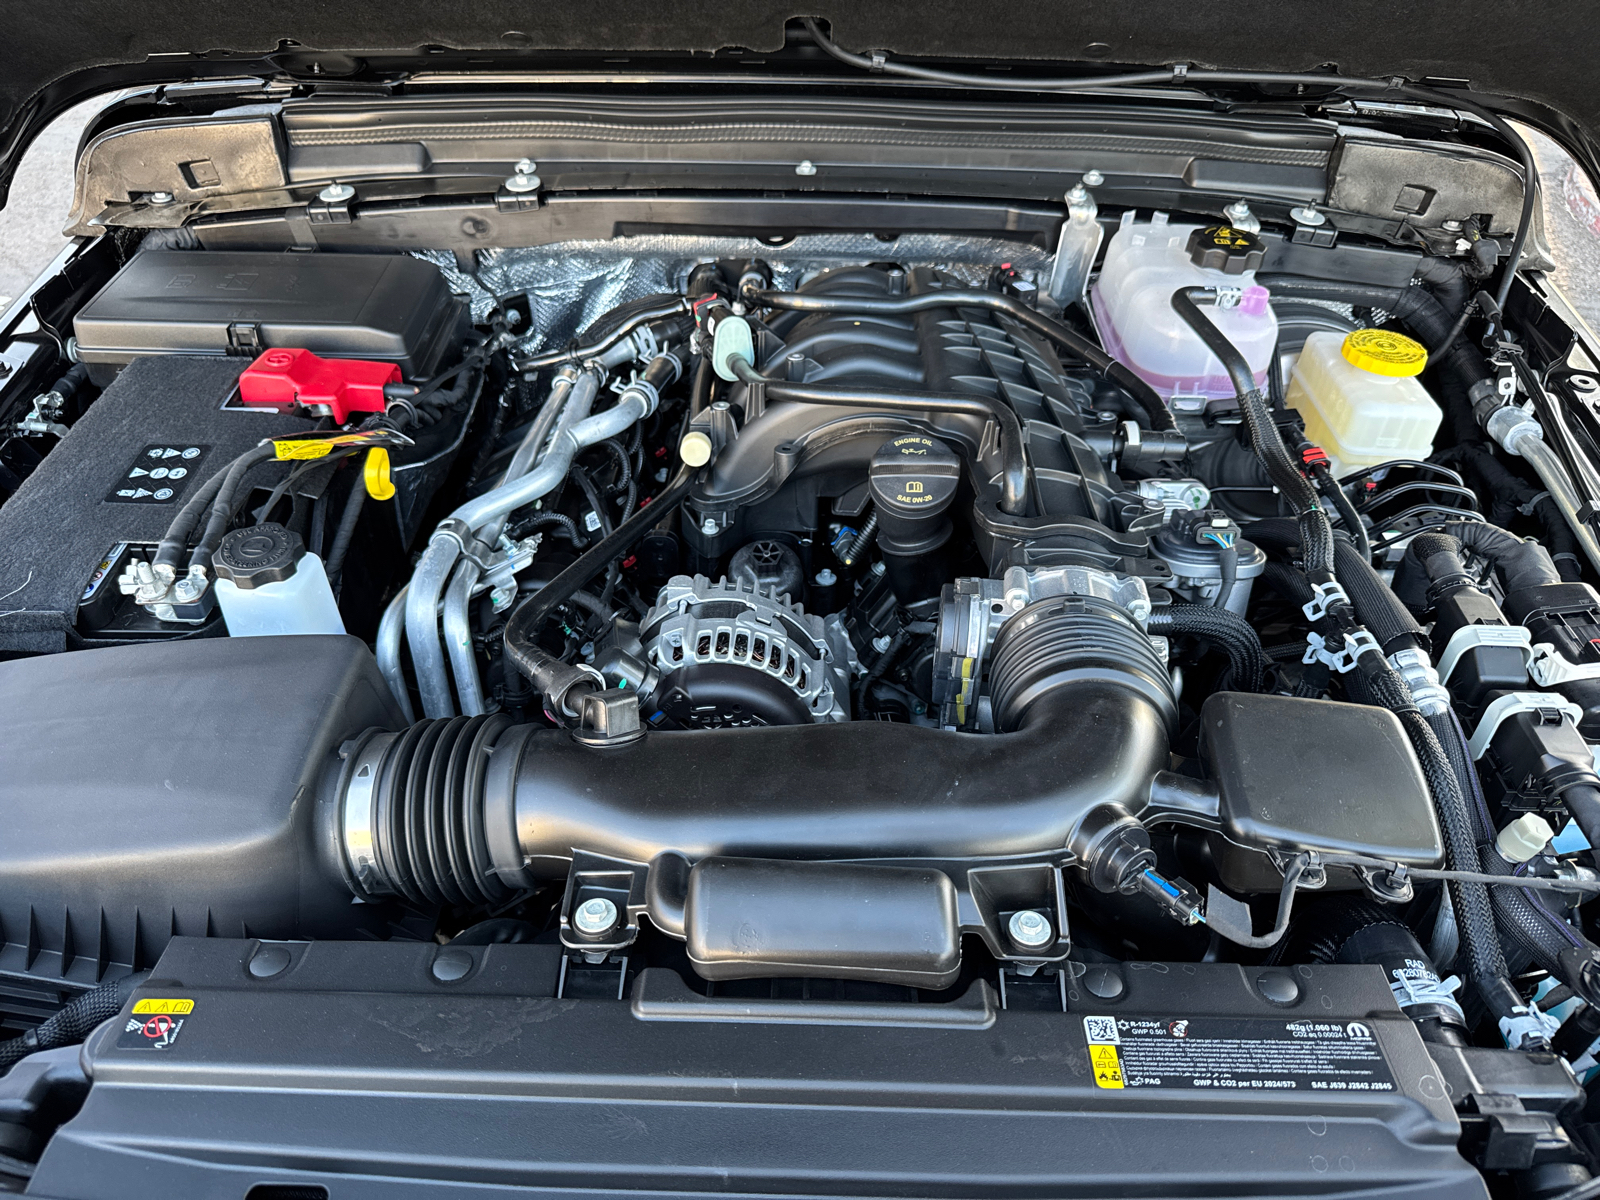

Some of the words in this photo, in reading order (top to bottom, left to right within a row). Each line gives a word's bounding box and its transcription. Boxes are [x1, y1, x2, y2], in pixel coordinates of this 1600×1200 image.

[893, 437, 921, 447] ENGINE
[921, 438, 933, 447] OIL
[896, 494, 911, 503] SAE
[911, 494, 933, 503] 0W-20
[1404, 958, 1426, 970] RAD
[1130, 1021, 1161, 1029] R-1234yf
[1331, 1024, 1343, 1033] lb)
[1149, 1028, 1167, 1036] 0.501
[1144, 1077, 1161, 1085] PAG
[1213, 1079, 1220, 1087] &
[1220, 1079, 1237, 1087] CO2
